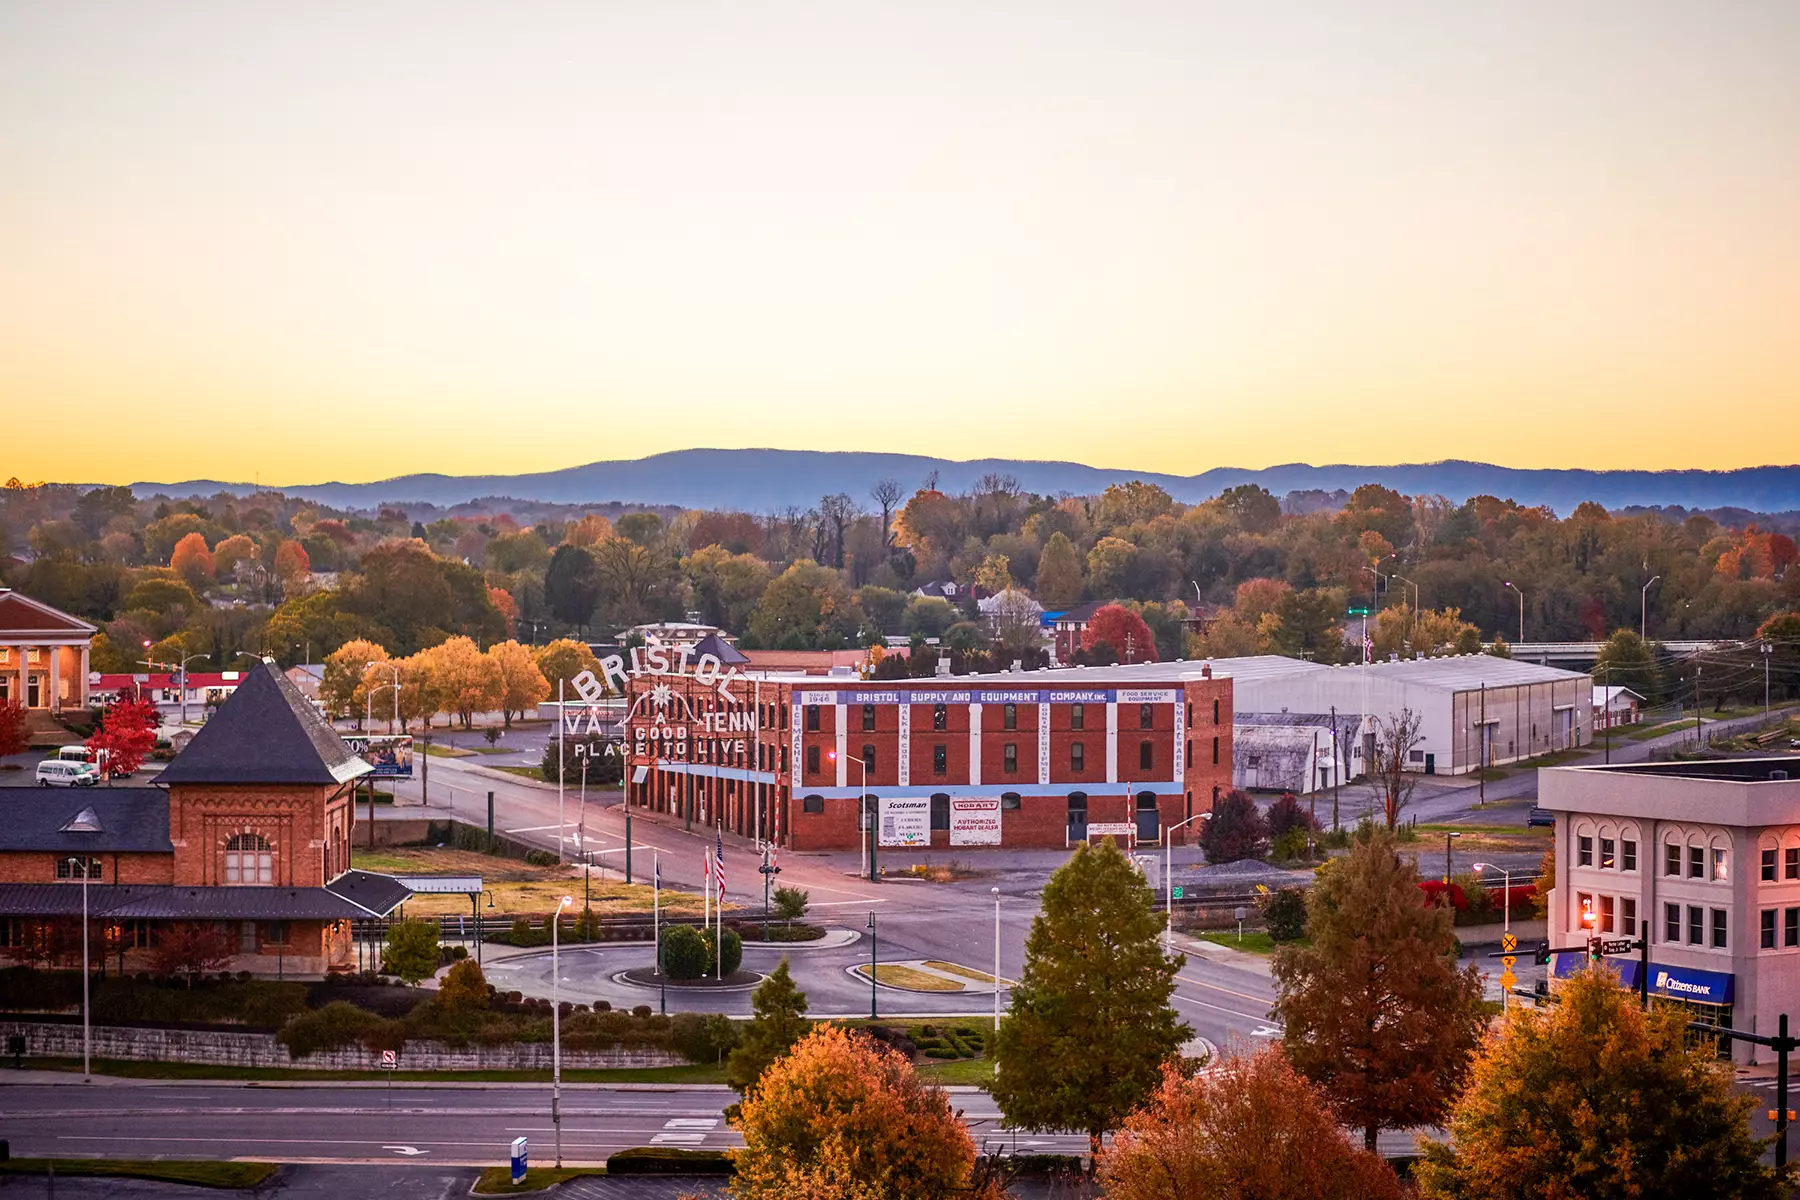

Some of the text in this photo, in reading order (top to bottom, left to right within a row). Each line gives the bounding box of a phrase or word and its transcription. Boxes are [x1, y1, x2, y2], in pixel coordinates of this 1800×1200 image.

[571, 645, 737, 705] BRISTOL
[856, 693, 900, 702] BRISTOL
[910, 692, 948, 702] SUPPLY
[952, 692, 971, 701] AND
[980, 692, 1038, 701] EQUIPMENT
[565, 712, 602, 735] VA
[655, 712, 666, 724] A
[703, 711, 755, 732] TENN
[635, 727, 687, 740] GOOD
[902, 730, 907, 740] IN
[1176, 704, 1184, 776] SMALLWARES
[574, 740, 745, 757] PLACE TO LIVE
[793, 728, 801, 784] MACHINES
[1666, 978, 1711, 995] Citizens BANK
